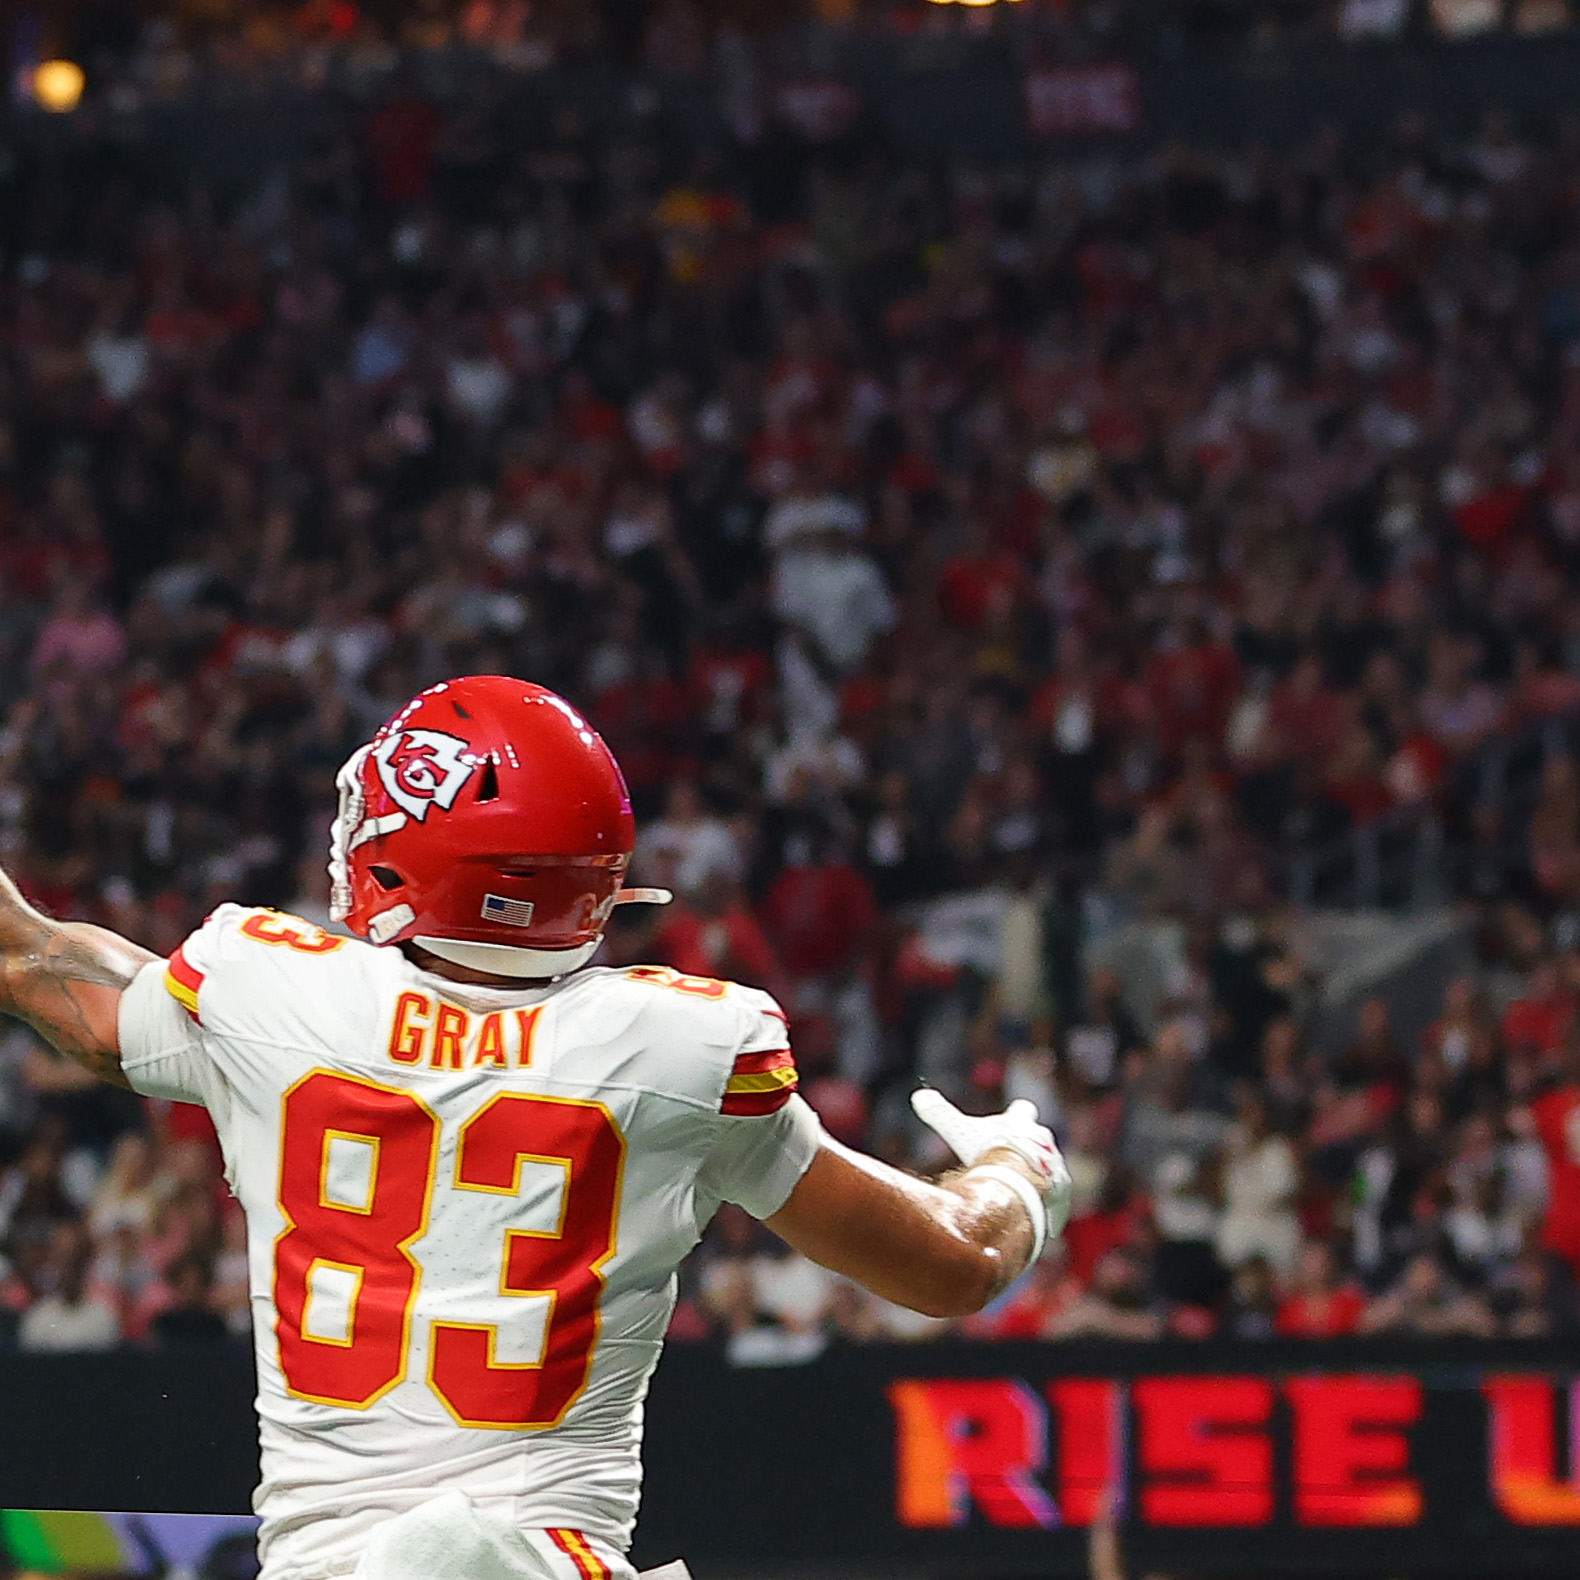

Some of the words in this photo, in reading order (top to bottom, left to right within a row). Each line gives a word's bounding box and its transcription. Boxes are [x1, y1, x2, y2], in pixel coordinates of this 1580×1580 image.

[388, 988, 551, 1073] GRAY
[272, 1066, 627, 1431] 83
[890, 1374, 1425, 1529] RISE
[1481, 1371, 1580, 1529] U
